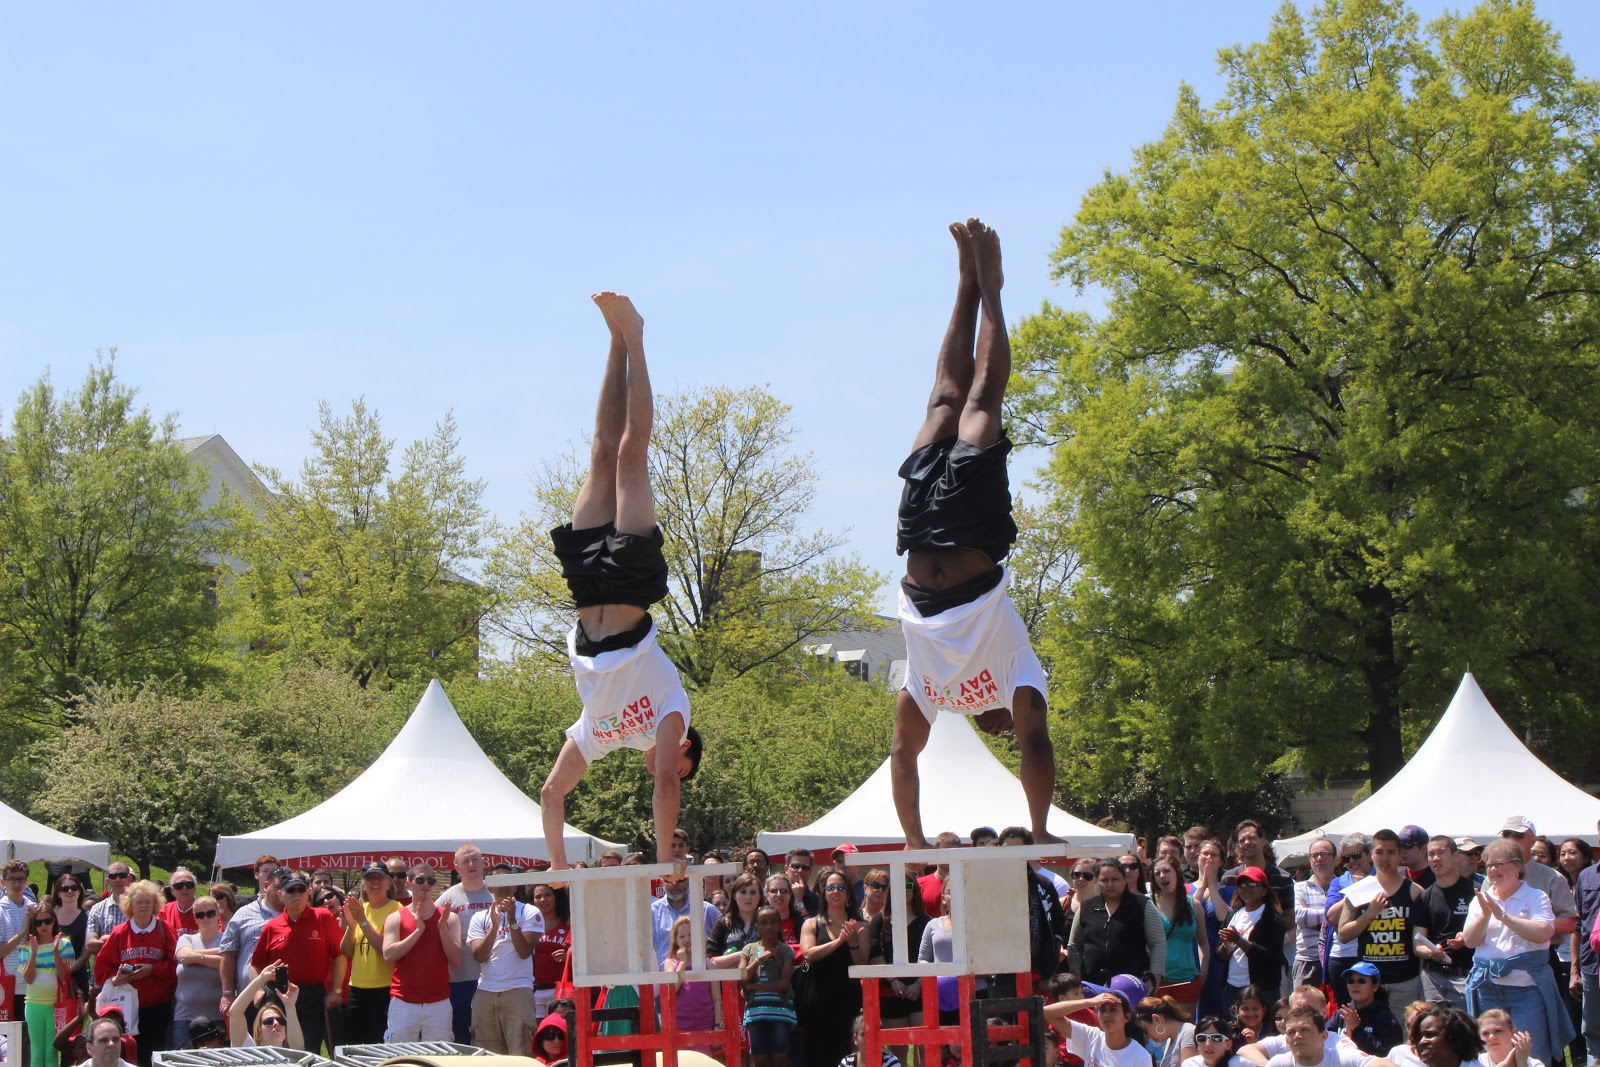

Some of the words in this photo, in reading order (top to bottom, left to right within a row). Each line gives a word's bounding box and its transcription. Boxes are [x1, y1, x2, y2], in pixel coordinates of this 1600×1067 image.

[960, 669, 993, 697] DAY
[622, 695, 651, 719] DAY
[320, 855, 375, 868] SMITH
[380, 855, 448, 869] SHOOL
[1369, 931, 1401, 943] YOU
[1365, 943, 1406, 956] MOVE
